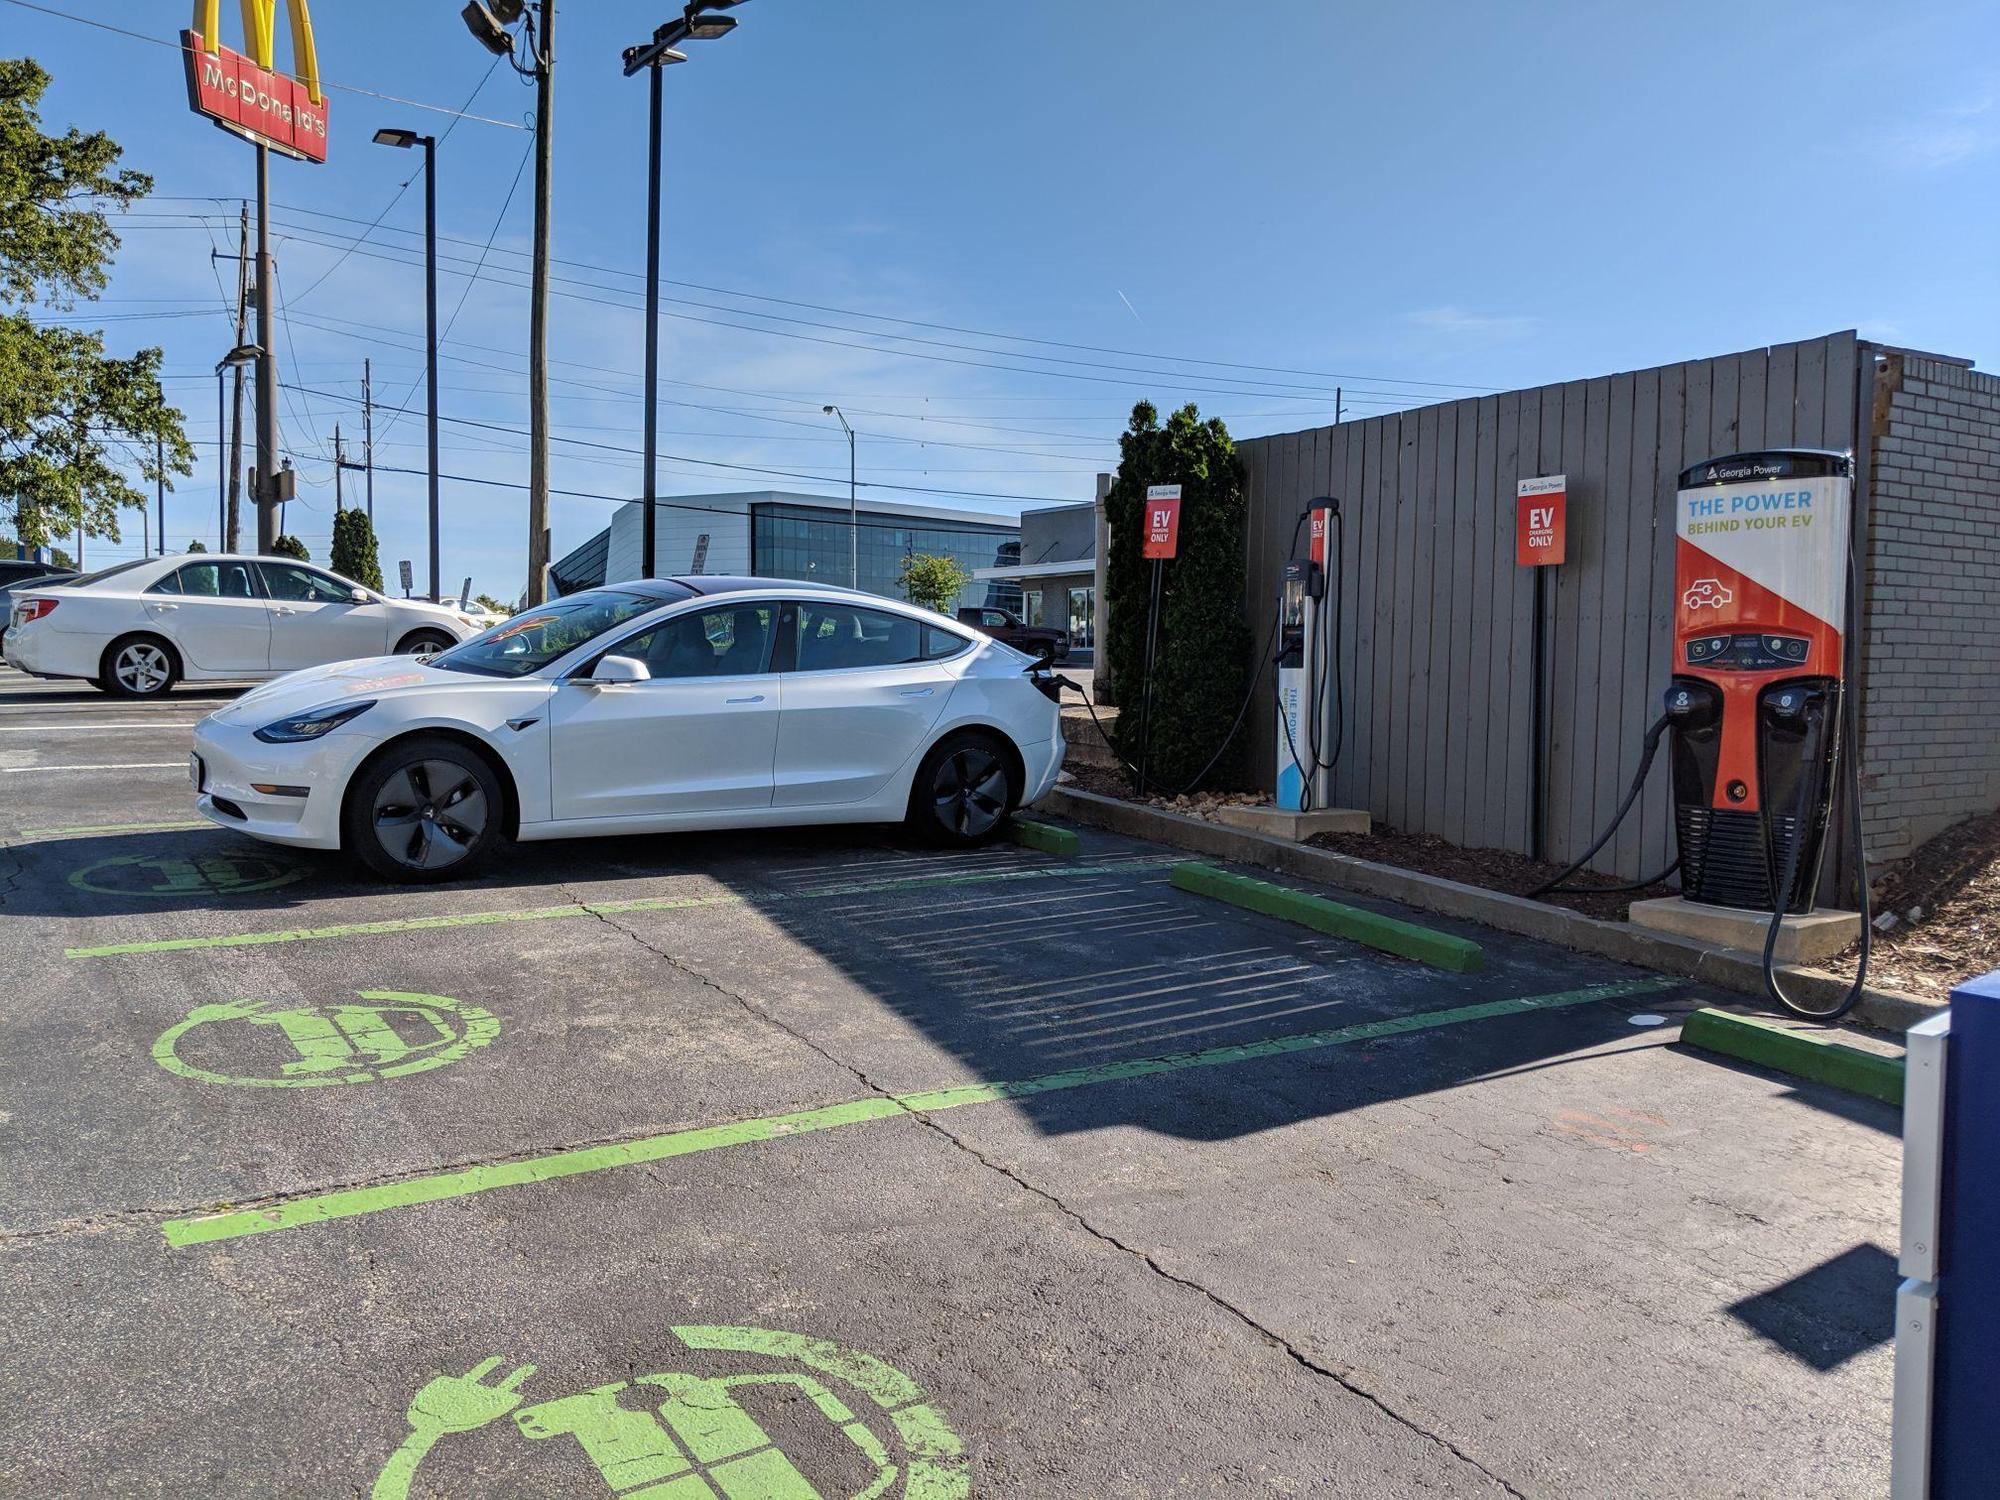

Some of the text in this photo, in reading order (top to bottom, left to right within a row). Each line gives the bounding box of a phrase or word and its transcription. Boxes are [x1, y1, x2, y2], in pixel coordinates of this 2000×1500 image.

[203, 63, 326, 138] McDonald's
[1719, 465, 1782, 478] Georgia Power
[1688, 491, 1812, 517] THE POWER
[1153, 510, 1171, 528] EV
[1313, 520, 1323, 530] EV
[1530, 507, 1554, 529] EV
[1688, 515, 1813, 535] BEHIND YOUR EV
[1151, 533, 1169, 543] ONLY
[1529, 535, 1553, 547] ONLY
[1289, 688, 1298, 748] THE POWE
